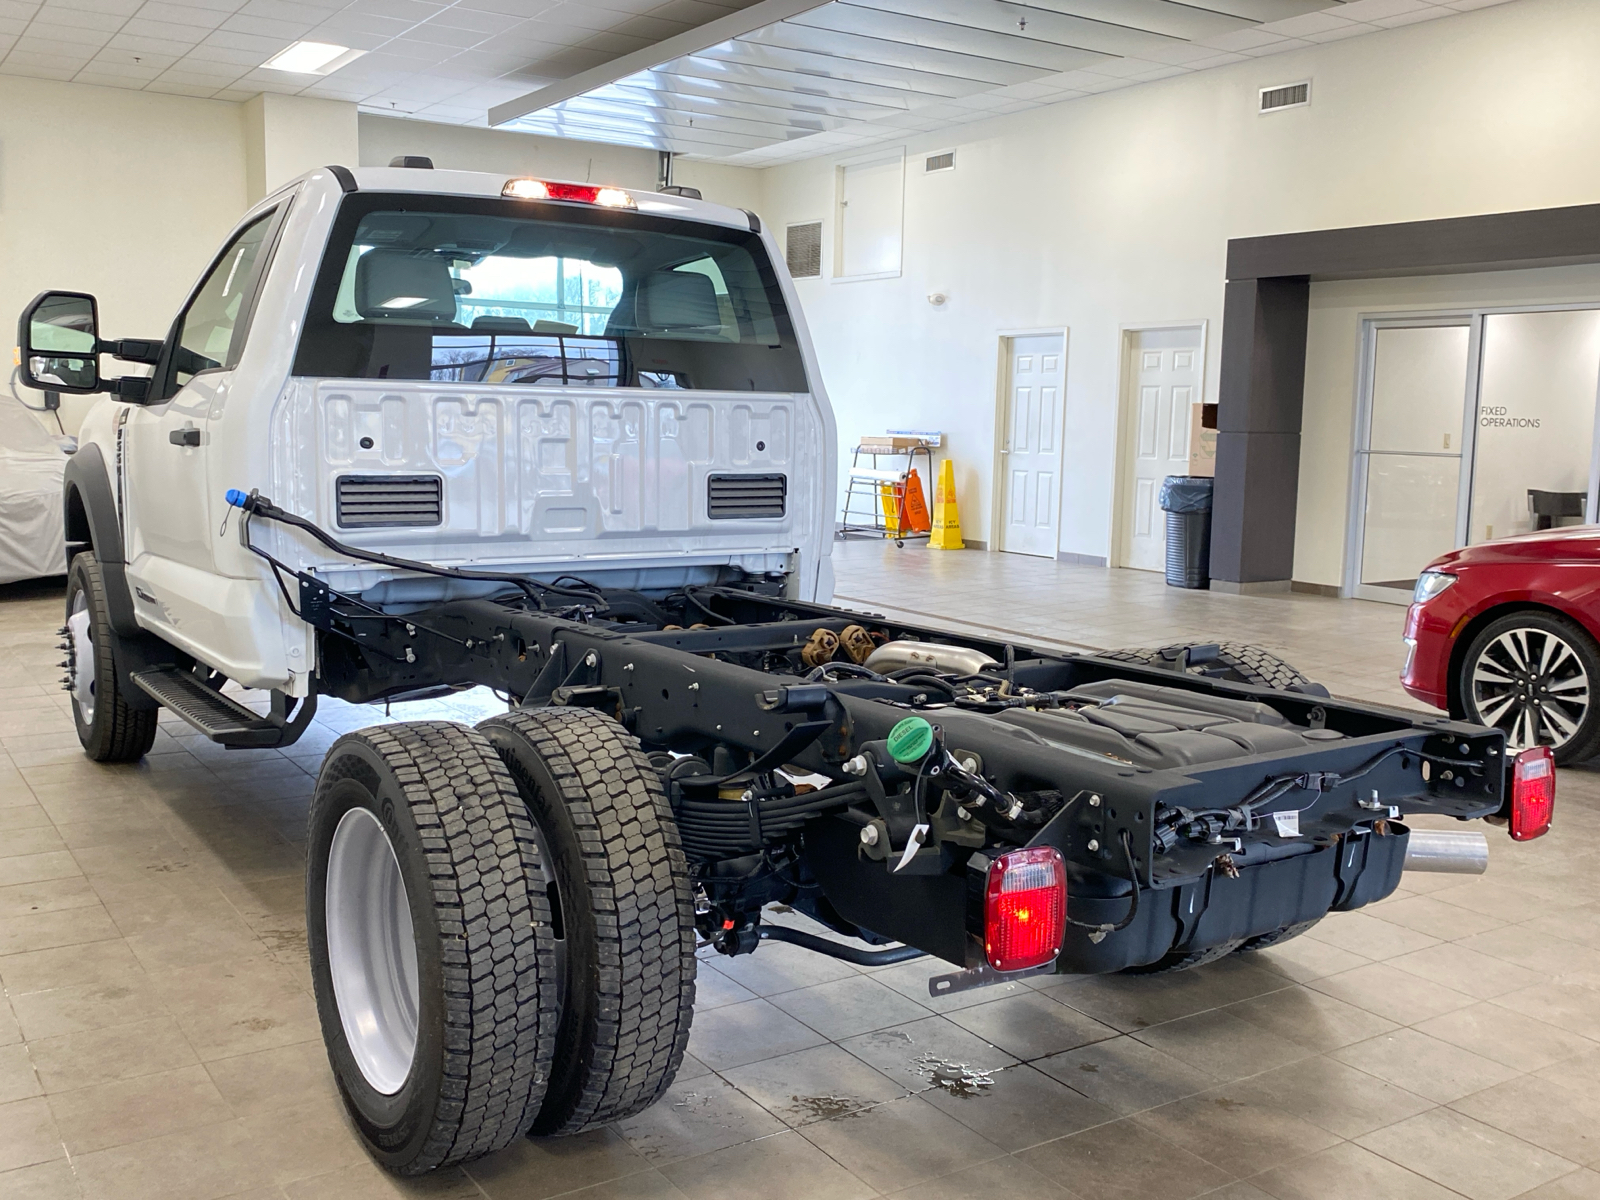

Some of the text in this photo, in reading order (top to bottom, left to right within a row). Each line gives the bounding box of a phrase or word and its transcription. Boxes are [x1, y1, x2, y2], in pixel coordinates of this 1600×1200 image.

[1481, 406, 1507, 416] FIXED
[1480, 417, 1541, 428] OPERATIONS
[893, 725, 914, 743] DIESEL
